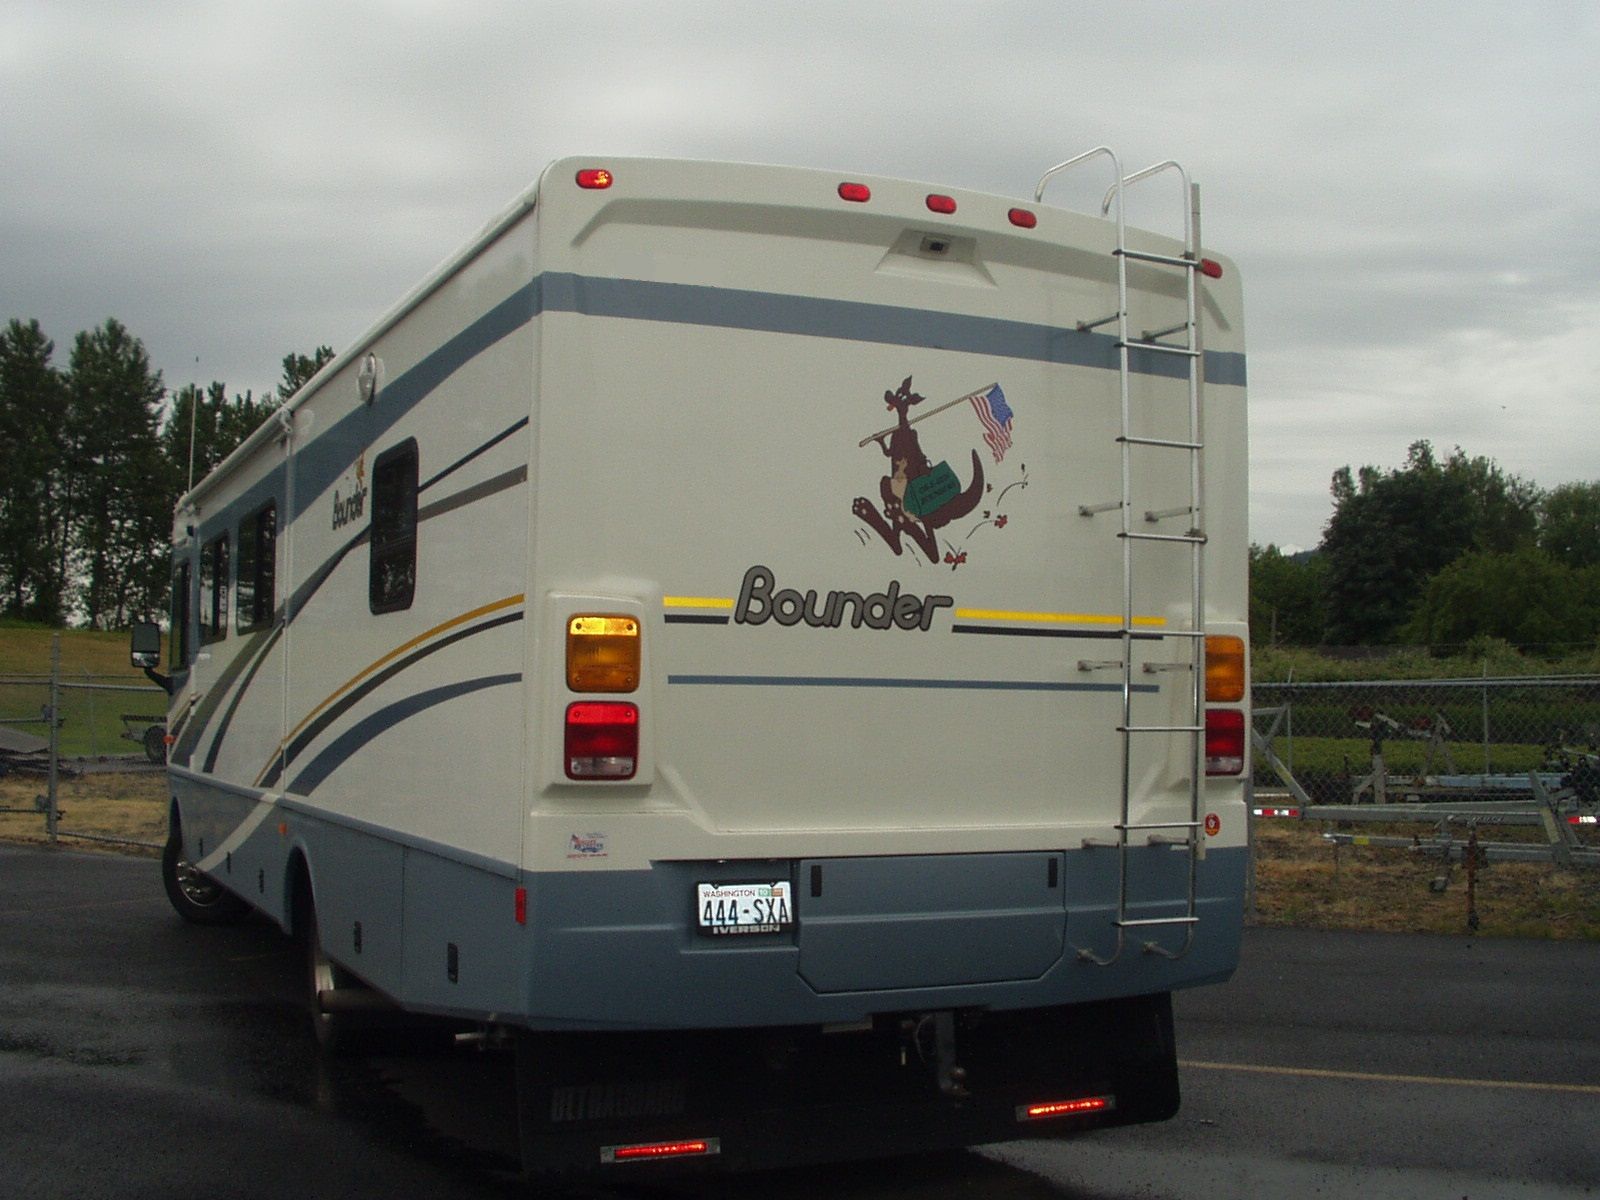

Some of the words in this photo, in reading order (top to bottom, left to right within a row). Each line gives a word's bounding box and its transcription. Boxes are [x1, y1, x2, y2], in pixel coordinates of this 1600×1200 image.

[734, 565, 954, 631] Bounder
[703, 889, 756, 897] WASHINGTON
[703, 898, 789, 926] 444-SXA
[713, 924, 780, 934] IVERSON
